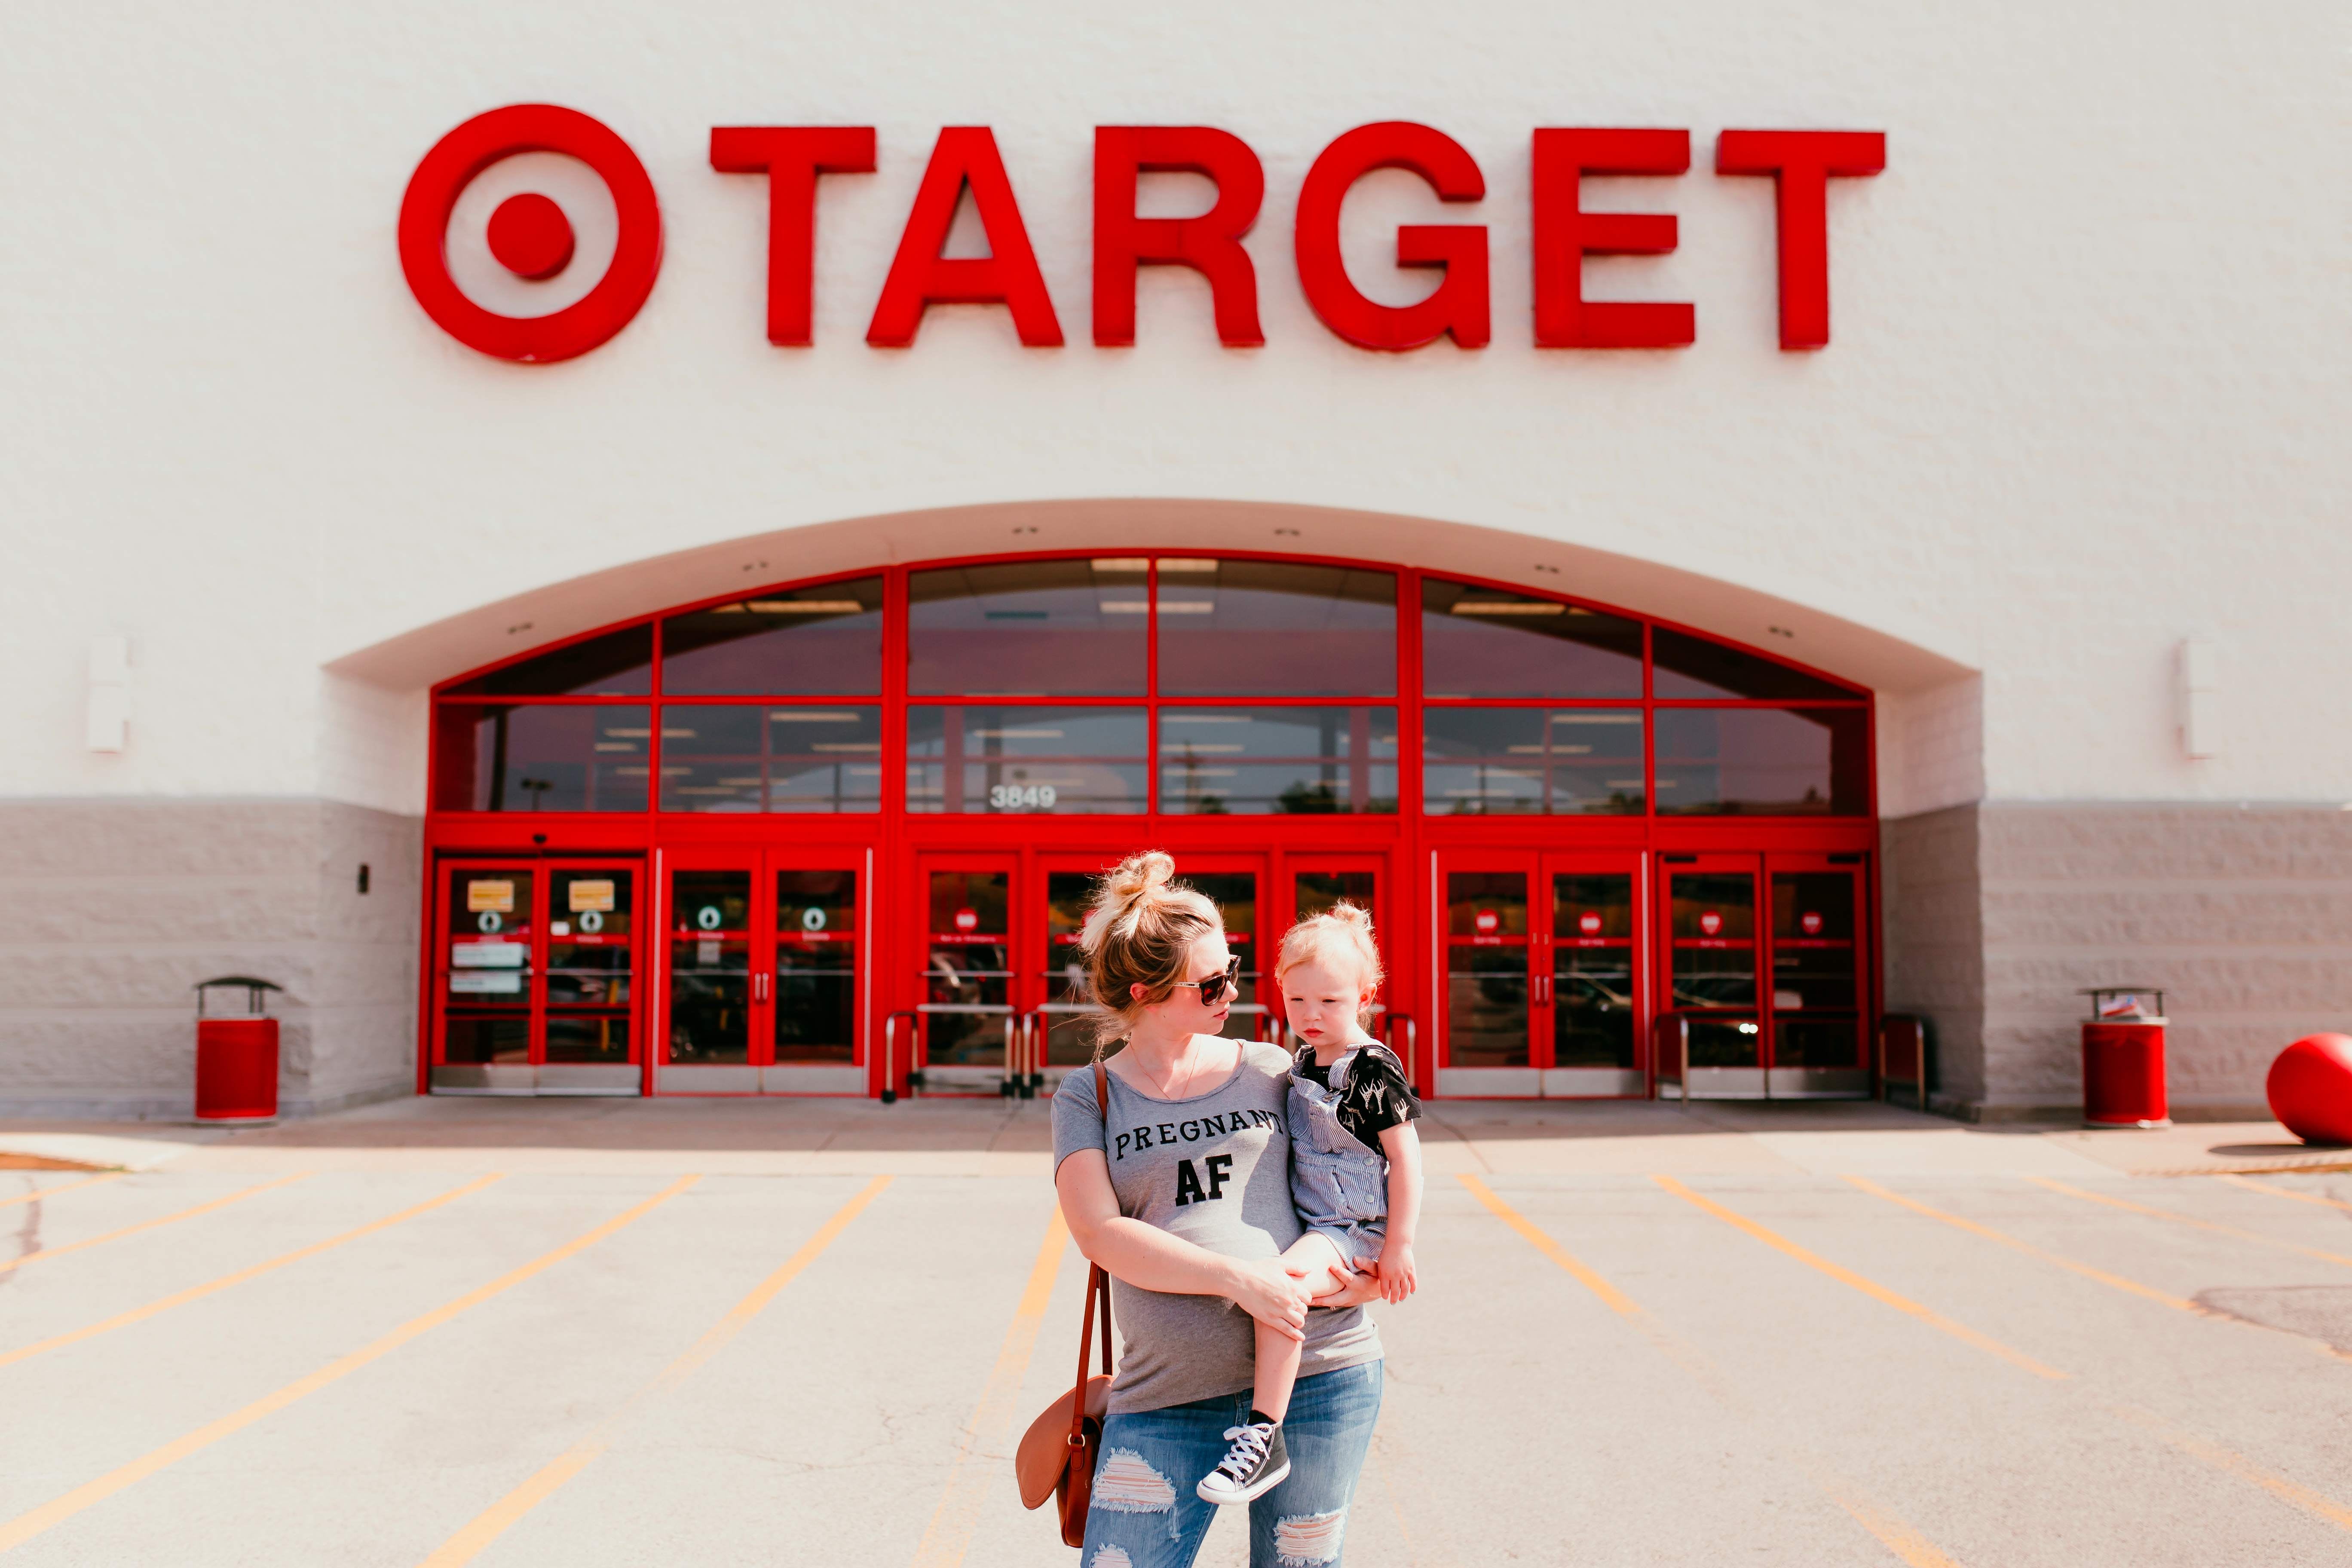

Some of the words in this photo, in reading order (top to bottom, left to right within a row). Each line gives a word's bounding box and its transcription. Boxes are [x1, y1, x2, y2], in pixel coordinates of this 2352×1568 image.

[709, 121, 1886, 352] TARGET
[990, 784, 1057, 808] 3849
[1116, 1109, 1283, 1160] PREGNANT
[1176, 1154, 1233, 1206] AF
